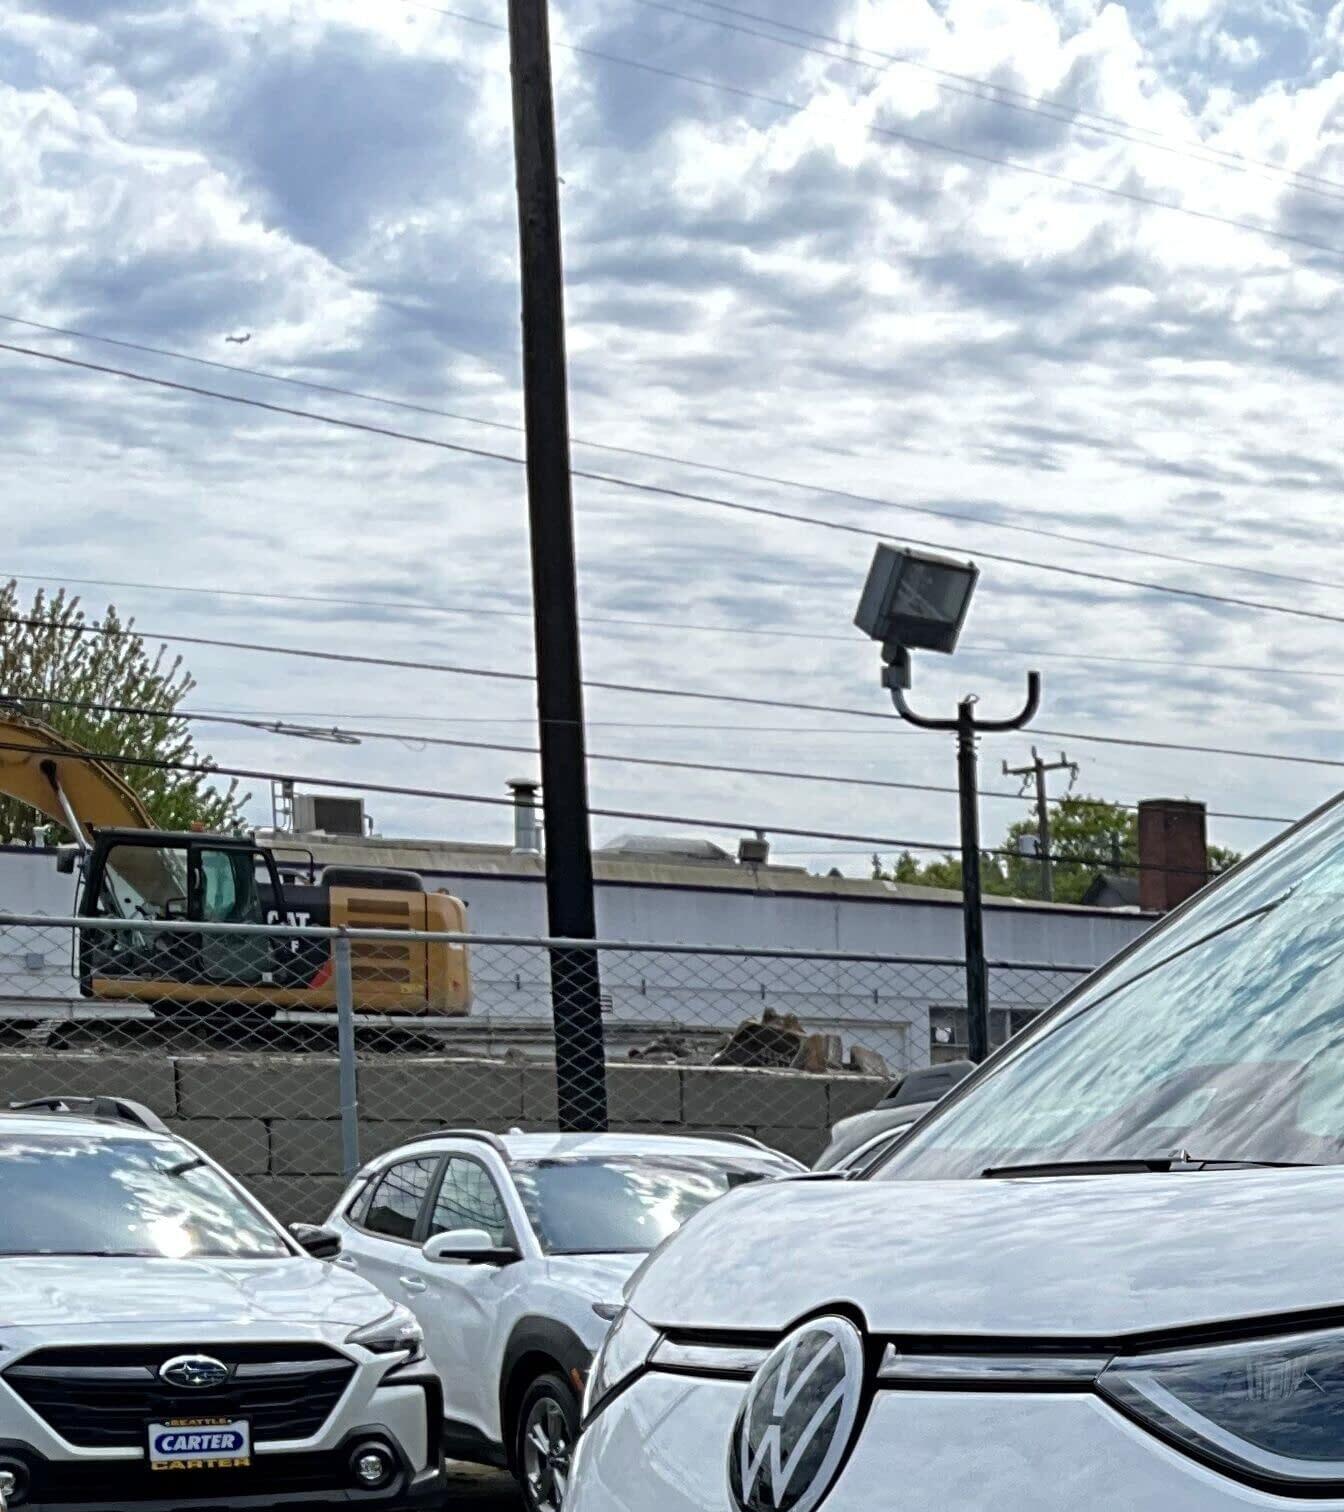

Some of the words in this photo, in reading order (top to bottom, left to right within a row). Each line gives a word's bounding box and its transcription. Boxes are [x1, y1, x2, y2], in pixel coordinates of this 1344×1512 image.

[170, 1417, 228, 1427] SEATTLE
[161, 1432, 236, 1451] CARTER
[151, 1458, 251, 1471] CARTER
